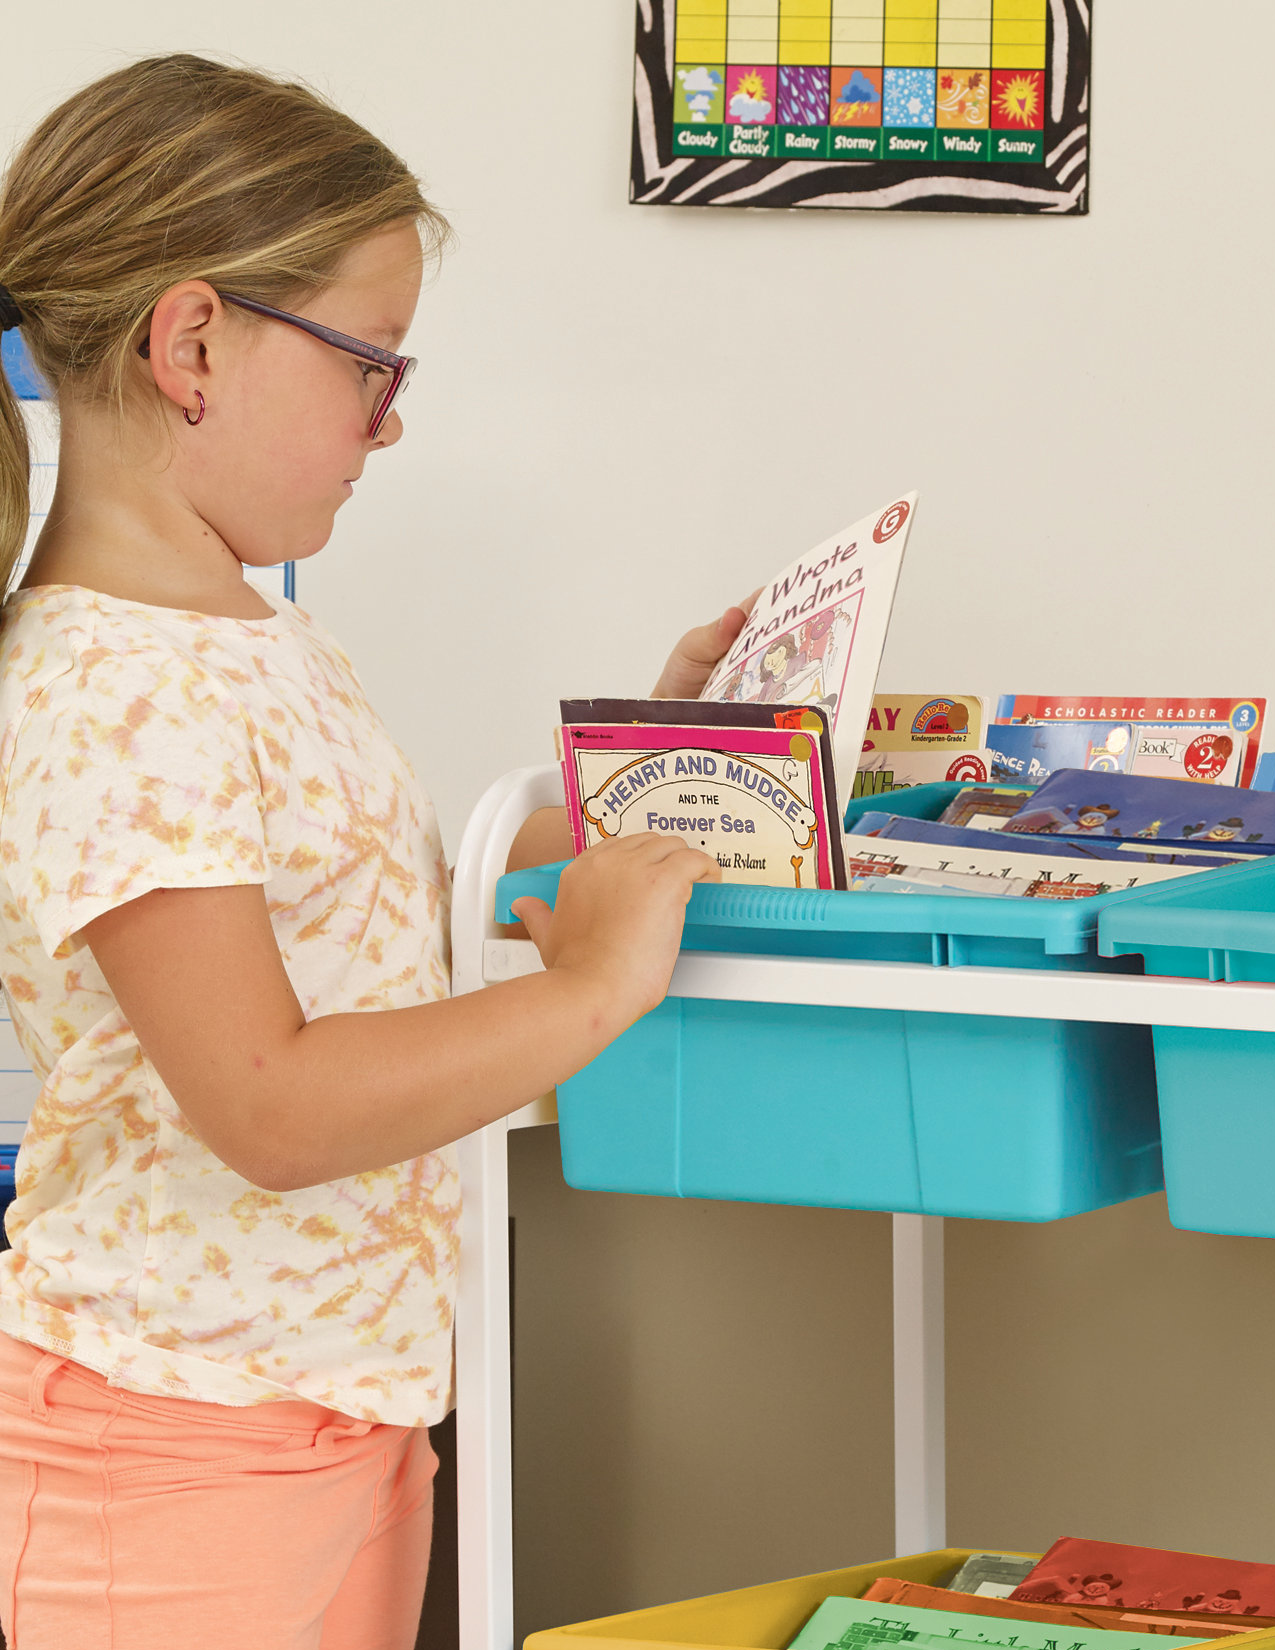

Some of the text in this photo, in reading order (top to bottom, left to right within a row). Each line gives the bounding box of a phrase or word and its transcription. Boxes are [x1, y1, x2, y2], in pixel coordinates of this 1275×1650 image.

[678, 130, 718, 148] Cloudy
[733, 125, 769, 141] Partly
[785, 133, 820, 150] Rainy
[729, 138, 770, 157] Cloudy
[834, 135, 877, 152] Stormy
[889, 136, 928, 153] Snowy
[943, 136, 982, 153] Windy
[997, 138, 1036, 155] Sunny
[881, 510, 900, 534] G
[771, 542, 858, 607] Wrote
[728, 567, 864, 666] Grandma
[1044, 707, 1218, 719] SCHOLASTIC READER
[1240, 709, 1249, 722] 3
[911, 735, 962, 743] Kindergarten-Grade
[1197, 746, 1213, 769] 2
[1187, 764, 1222, 779] WITH HELP
[603, 756, 802, 823] HENRY AND MUDGE
[678, 794, 720, 805] AND THE
[646, 812, 756, 834] Forever Sea
[733, 853, 767, 871] Rylant
